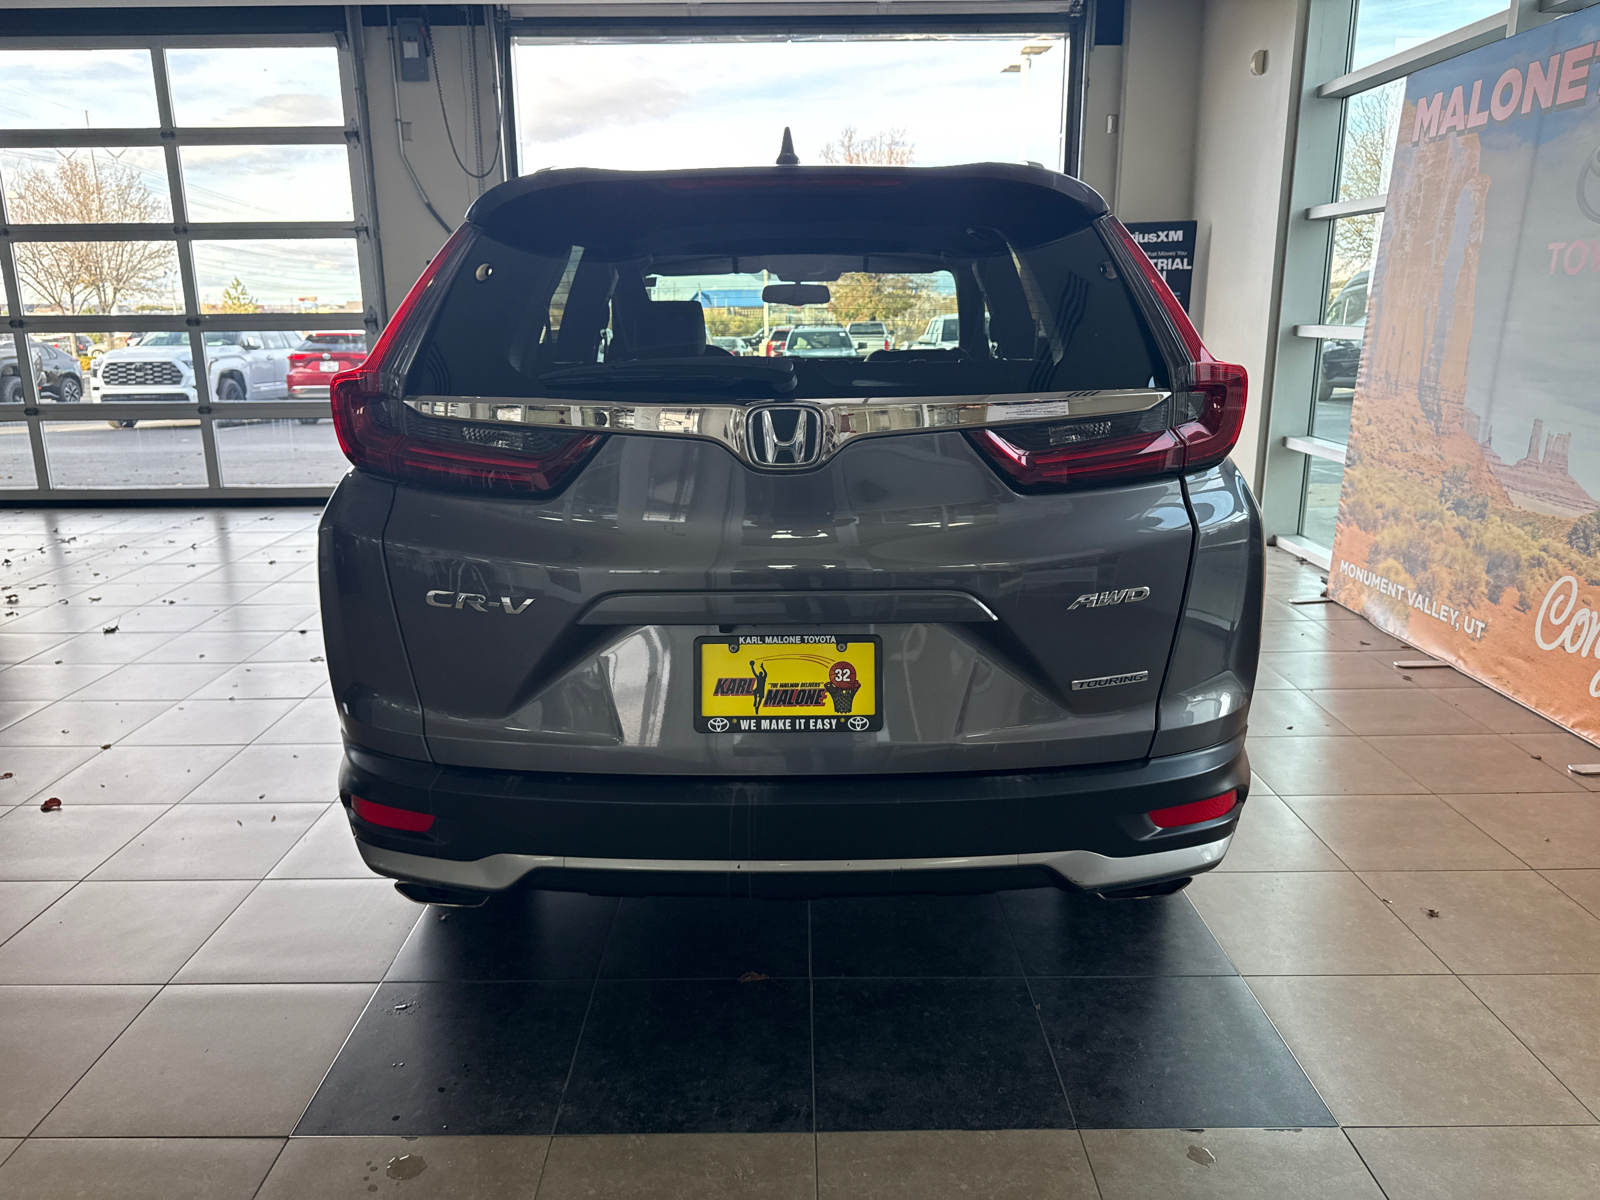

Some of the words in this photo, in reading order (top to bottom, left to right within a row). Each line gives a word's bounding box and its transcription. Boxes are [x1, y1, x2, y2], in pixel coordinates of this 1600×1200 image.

[1411, 40, 1600, 143] MALONE
[425, 589, 537, 615] CR-V
[1067, 586, 1150, 610] AWD
[1339, 559, 1404, 601] MONUMENT
[1407, 590, 1460, 632] VALLEY,
[1463, 616, 1486, 639] UT
[739, 636, 763, 644] KARL
[765, 636, 801, 644] MALONE
[803, 635, 837, 644] TOYOTA
[834, 668, 851, 682] 32
[1078, 673, 1145, 689] TOURING
[713, 678, 756, 696] KARL
[763, 689, 827, 707] MALONE
[740, 719, 756, 730] WE
[761, 719, 791, 730] MAKE
[795, 719, 805, 730] IT
[809, 718, 837, 730] EASY
